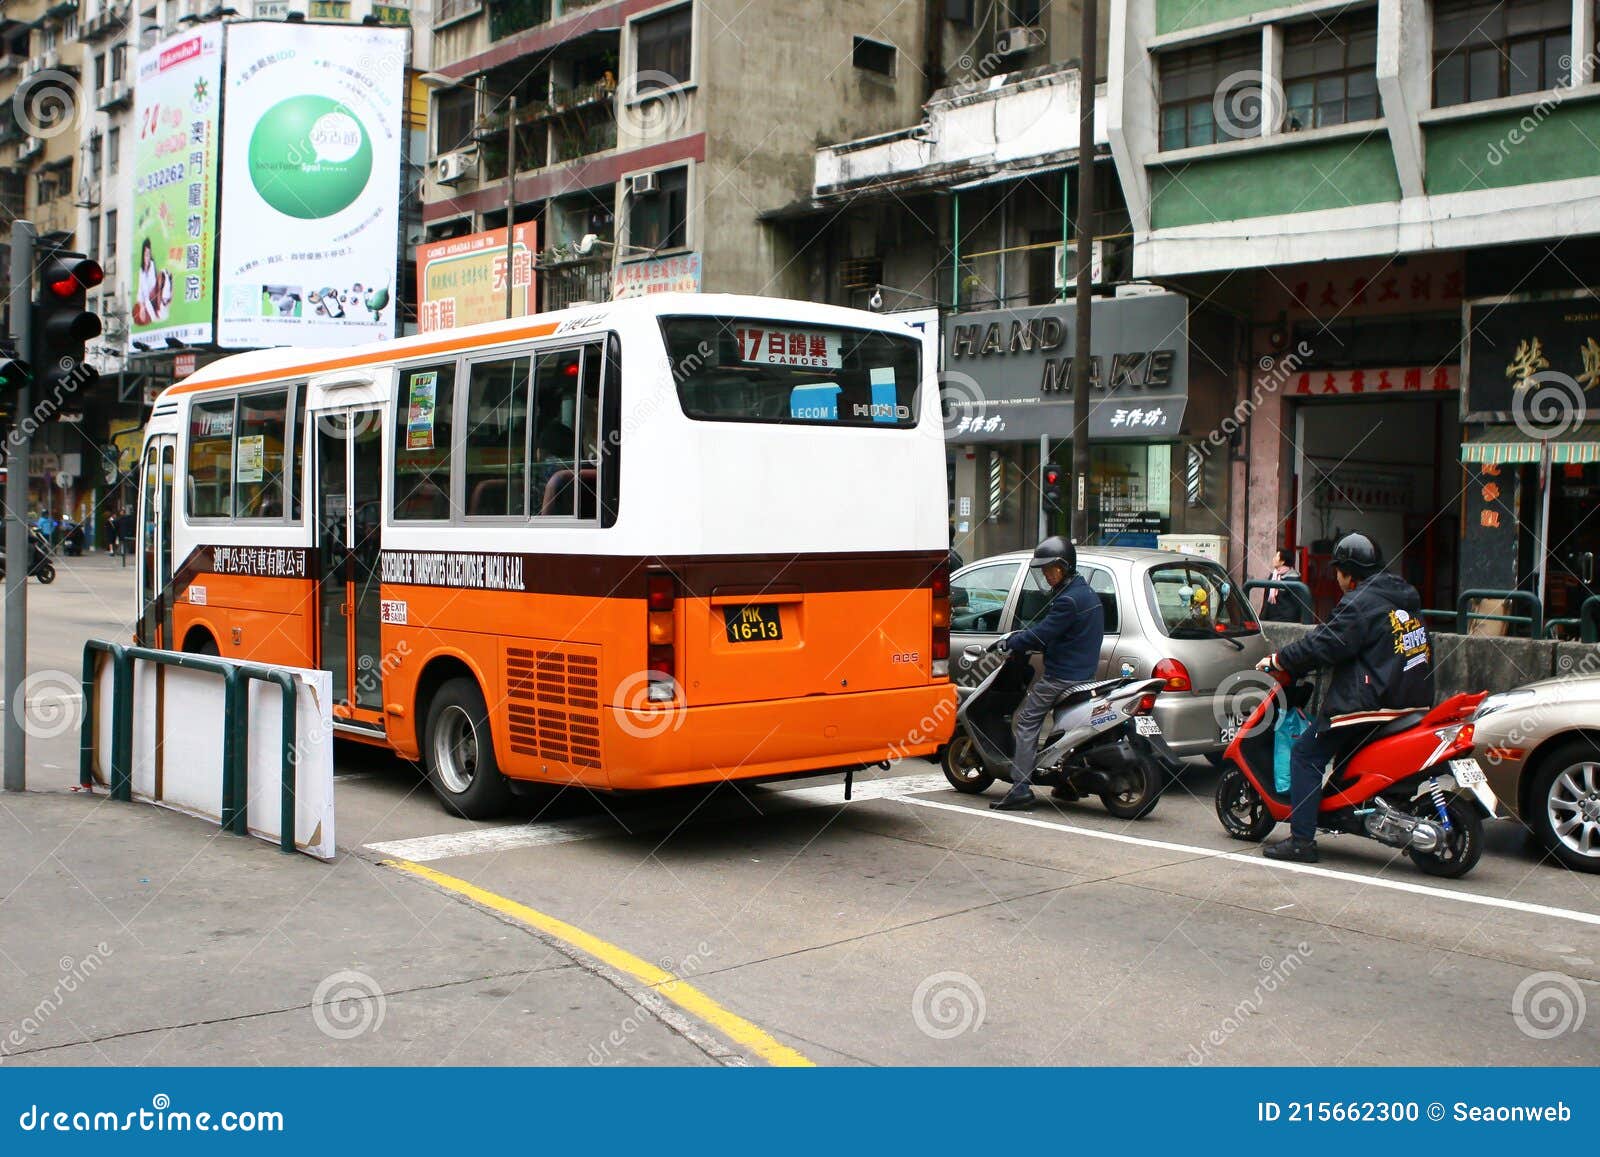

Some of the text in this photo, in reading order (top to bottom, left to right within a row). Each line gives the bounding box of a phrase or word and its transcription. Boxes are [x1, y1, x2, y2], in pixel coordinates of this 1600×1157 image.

[953, 316, 1067, 358] HAND
[768, 355, 829, 367] CAMOES
[853, 403, 910, 419] HINO
[213, 546, 306, 577] 澳門公共汽車有限公司
[390, 602, 405, 612] EXIT
[742, 607, 762, 623] MK
[732, 621, 779, 641] 16-13
[891, 651, 921, 665] ABS
